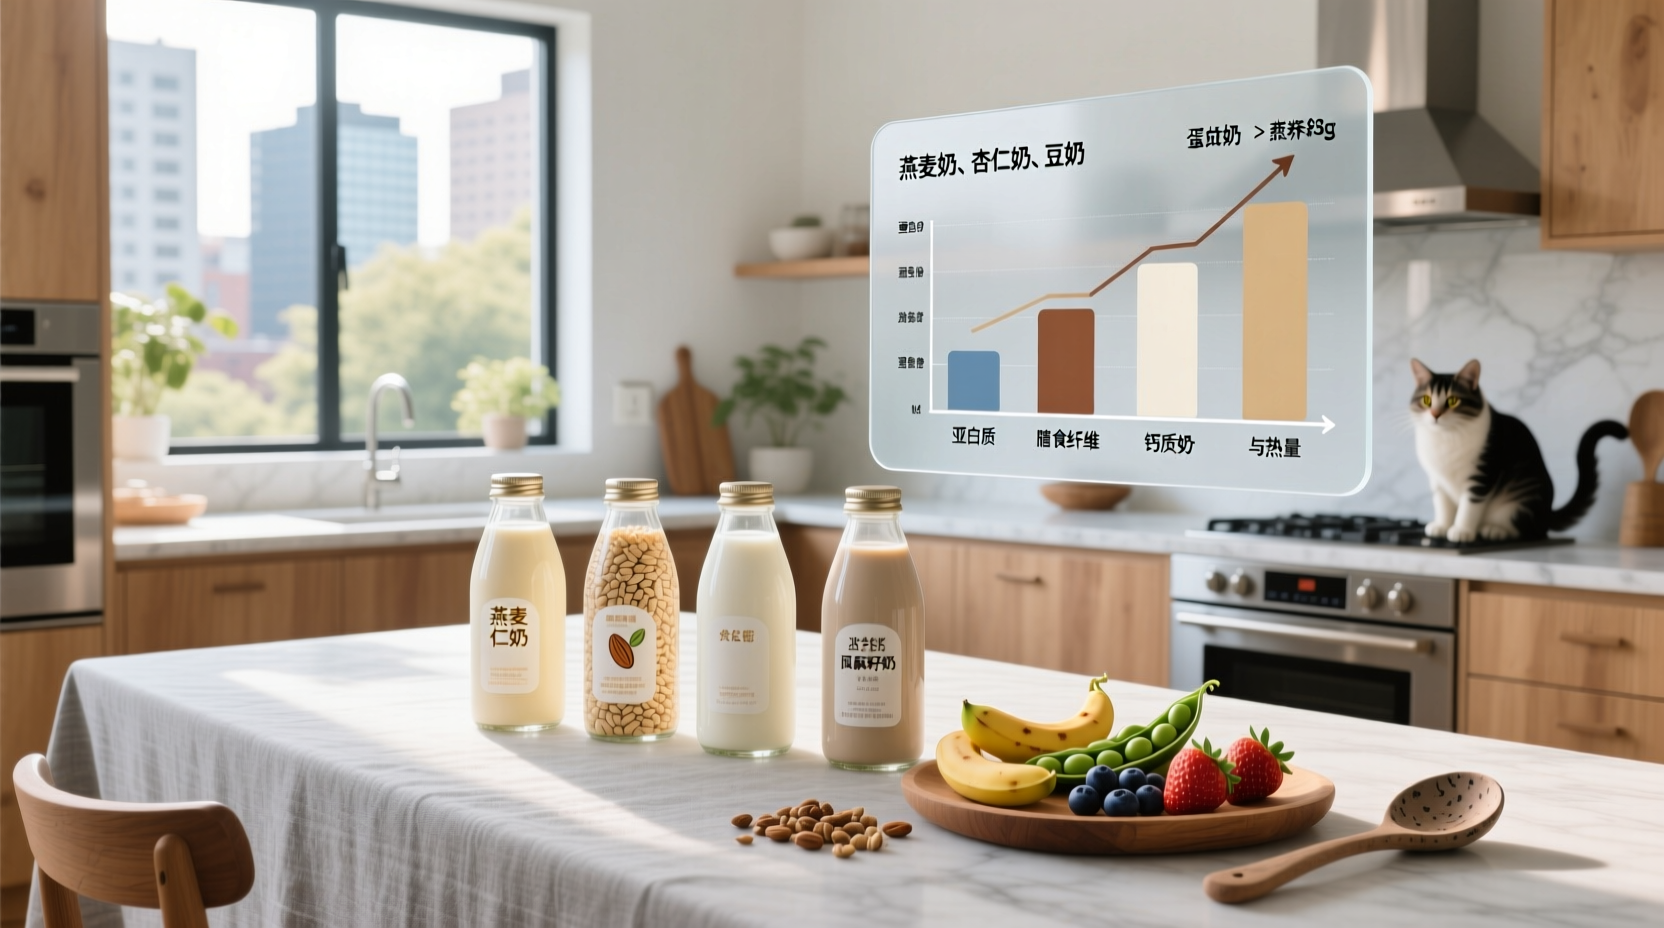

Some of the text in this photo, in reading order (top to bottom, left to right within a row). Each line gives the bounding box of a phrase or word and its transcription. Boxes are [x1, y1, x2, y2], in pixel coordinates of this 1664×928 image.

[899, 140, 1086, 181] 燕麦奶、杏仁奶、豆奶
[1249, 436, 1301, 458] 与热量
[489, 605, 528, 626] 燕麦
[489, 626, 528, 648] 仁奶
